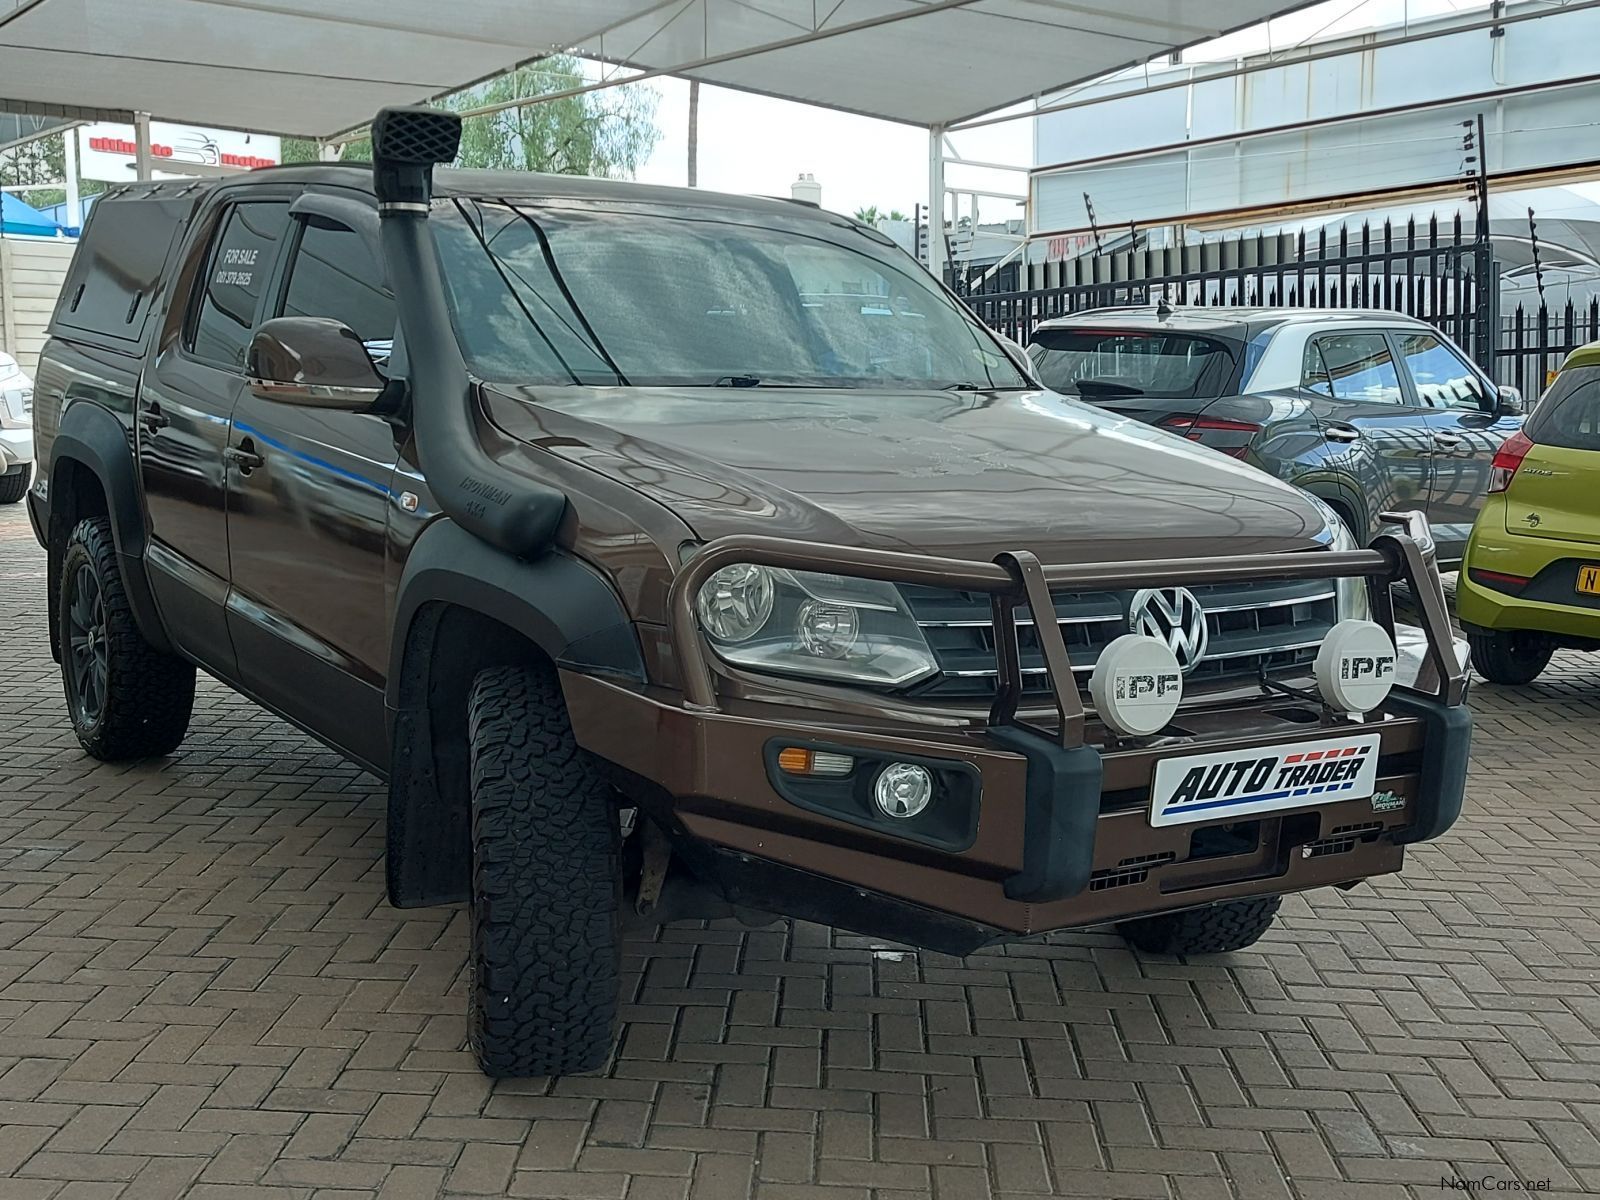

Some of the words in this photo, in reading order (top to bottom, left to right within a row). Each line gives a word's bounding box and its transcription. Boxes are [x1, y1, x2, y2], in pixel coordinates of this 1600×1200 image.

[89, 137, 173, 157] ultimte
[223, 248, 240, 264] FOR
[238, 249, 259, 265] SALE
[1584, 569, 1597, 591] N
[1341, 656, 1394, 680] IPF
[1116, 674, 1179, 700] IPF
[1167, 756, 1279, 805] AUTO
[1273, 757, 1366, 790] TRADER
